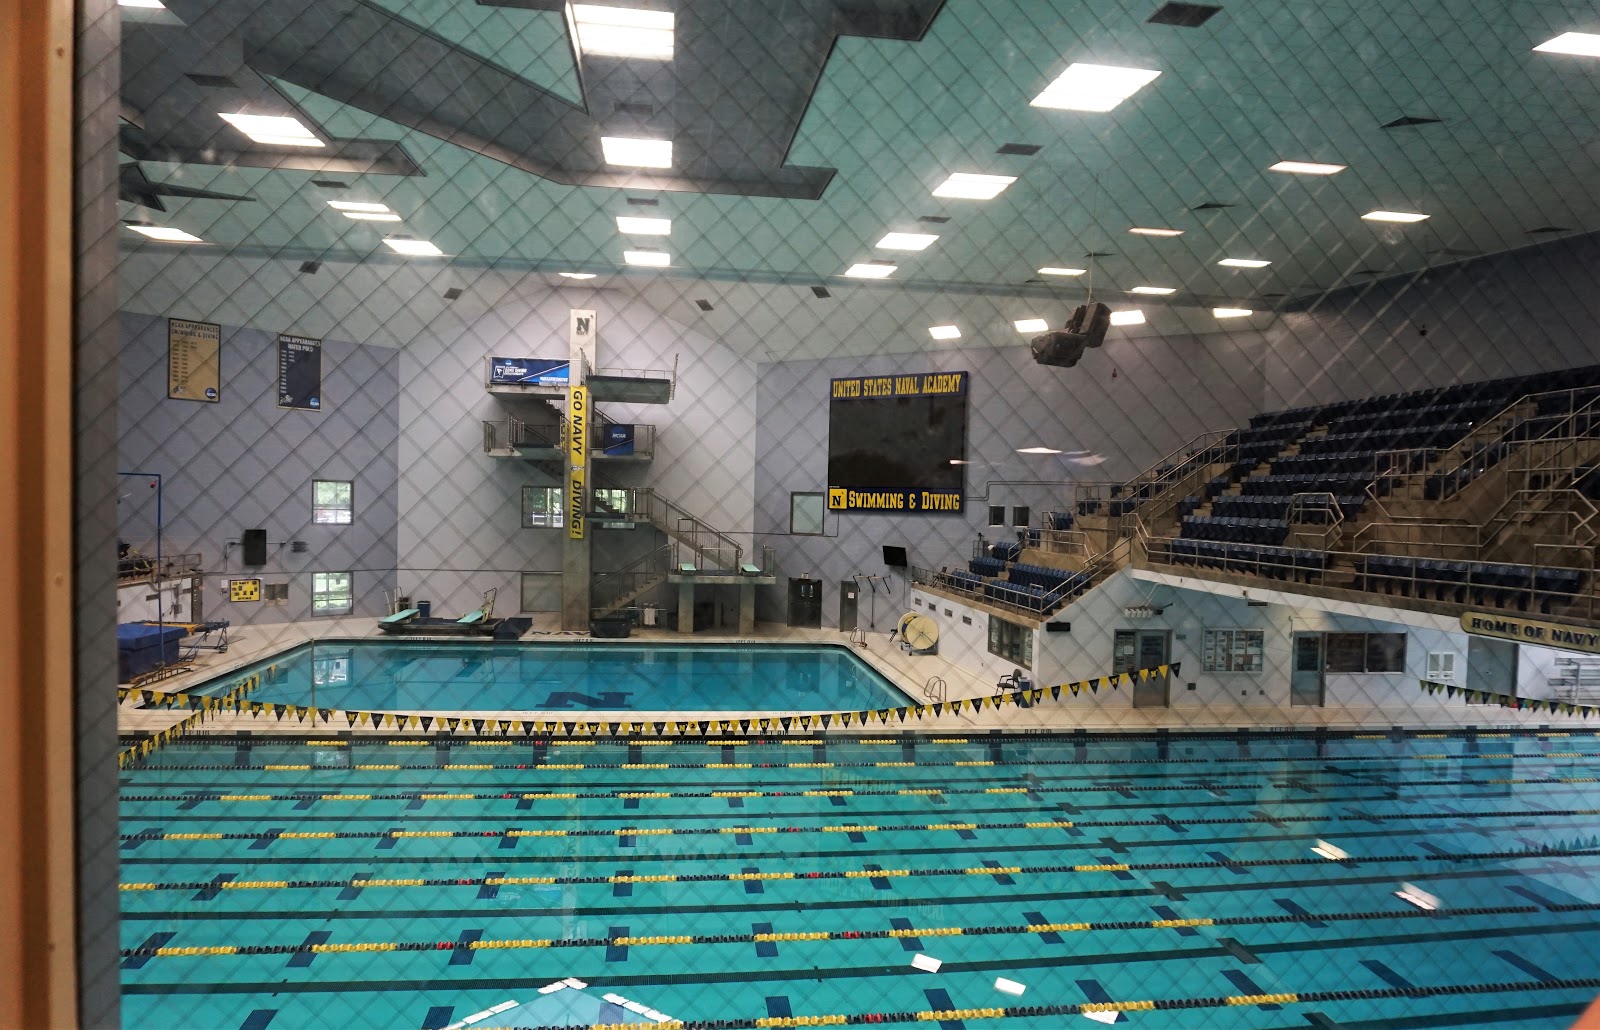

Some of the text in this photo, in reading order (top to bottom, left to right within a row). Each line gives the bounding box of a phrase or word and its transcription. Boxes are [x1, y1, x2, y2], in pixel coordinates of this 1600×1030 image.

[287, 343, 302, 351] WATER
[291, 337, 320, 347] APPEARANCES
[833, 374, 962, 398] UNITED STATES NAVAL ACADEMY
[572, 390, 583, 455] GO NAVY
[571, 482, 582, 535] DIVING!
[832, 495, 841, 506] N
[848, 490, 960, 510] SWIMMING & DIVING
[1471, 617, 1598, 647] HOME OF NAVY
[535, 692, 634, 708] N
